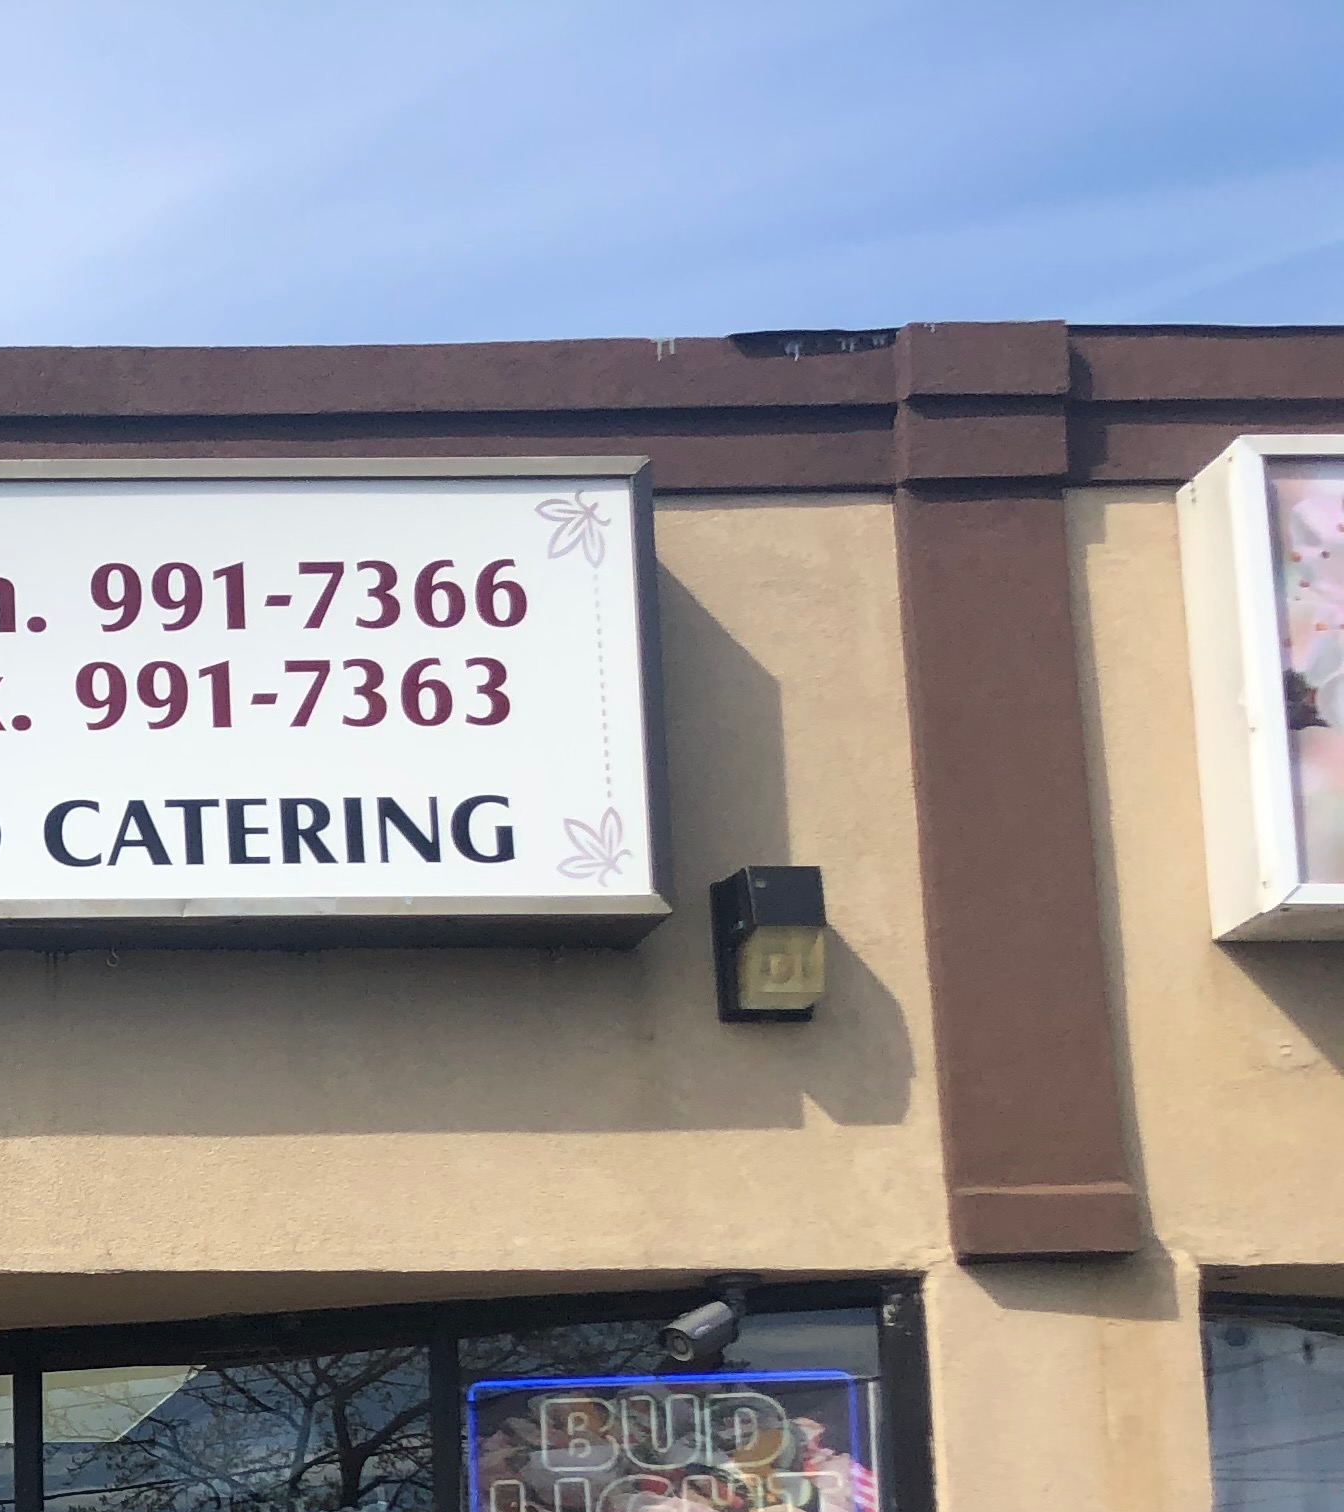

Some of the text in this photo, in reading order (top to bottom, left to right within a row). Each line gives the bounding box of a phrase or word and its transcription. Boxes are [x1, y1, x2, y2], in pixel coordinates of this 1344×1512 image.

[91, 557, 529, 636] 991-7366
[74, 658, 513, 731] 991-7363
[42, 795, 516, 869] CATERING
[540, 1392, 792, 1472] BUD
